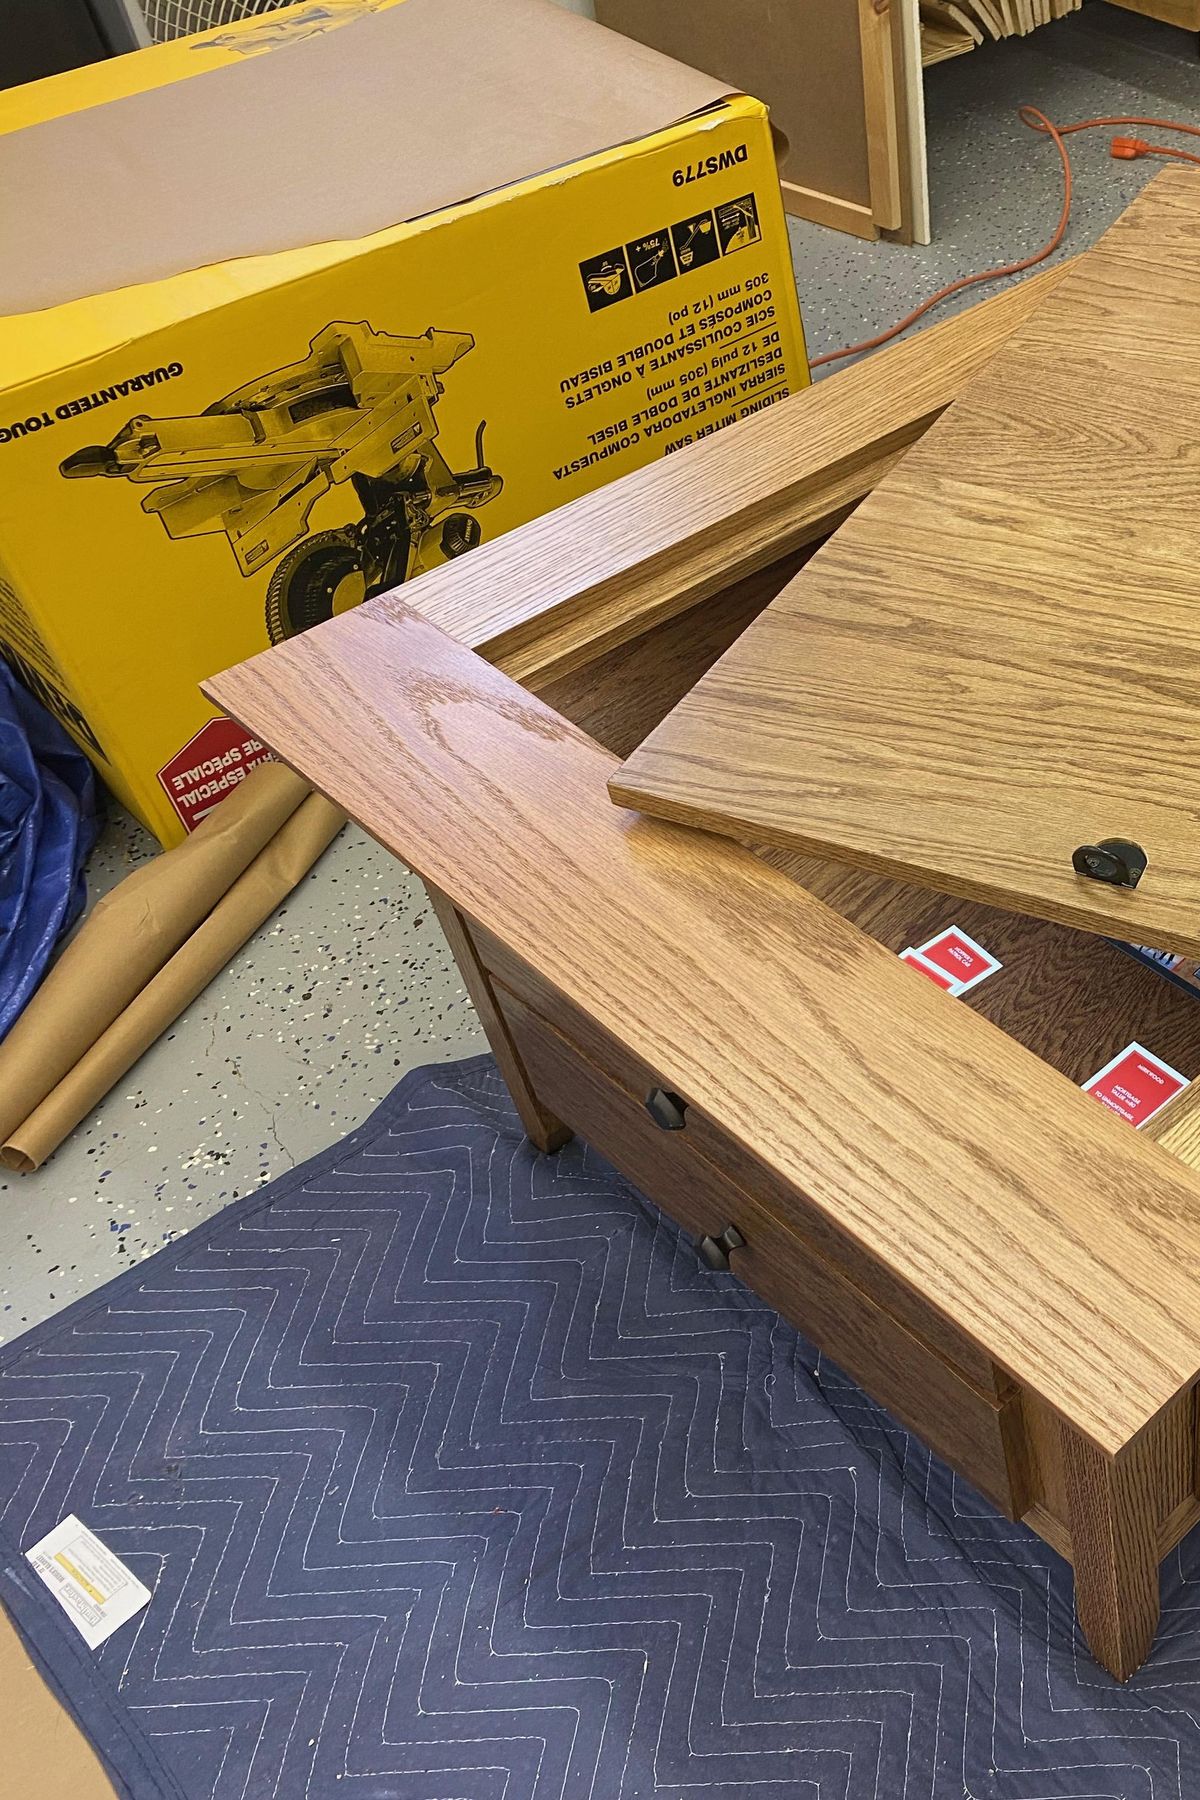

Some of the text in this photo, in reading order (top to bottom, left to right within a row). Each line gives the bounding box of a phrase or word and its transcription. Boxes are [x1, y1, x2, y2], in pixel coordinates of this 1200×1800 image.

[672, 143, 748, 187] DWS779
[642, 238, 661, 251] 75%
[668, 272, 768, 325] 305 mm (12 po)
[559, 289, 771, 392] COMPOSÉS ET DOUBLE BISEAU
[564, 305, 774, 408] SCIE COULISSANTE À ONGLETS
[646, 330, 779, 400] DE 12 pulg (305 mm)
[55, 362, 184, 420] GUARANTEED
[586, 346, 782, 445] DESLIZANTE DE DOBLE BISEL
[552, 363, 785, 480] SIERRA INGLETADORA COMPUESTA
[664, 387, 789, 456] SLIDING MITER SAW
[171, 747, 242, 791] SPÉCIALE
[177, 766, 247, 808] ESPECIAL
[1095, 1090, 1103, 1098] TO
[1111, 1087, 1126, 1101] VALUE
[1114, 1084, 1141, 1105] MORTGAGE
